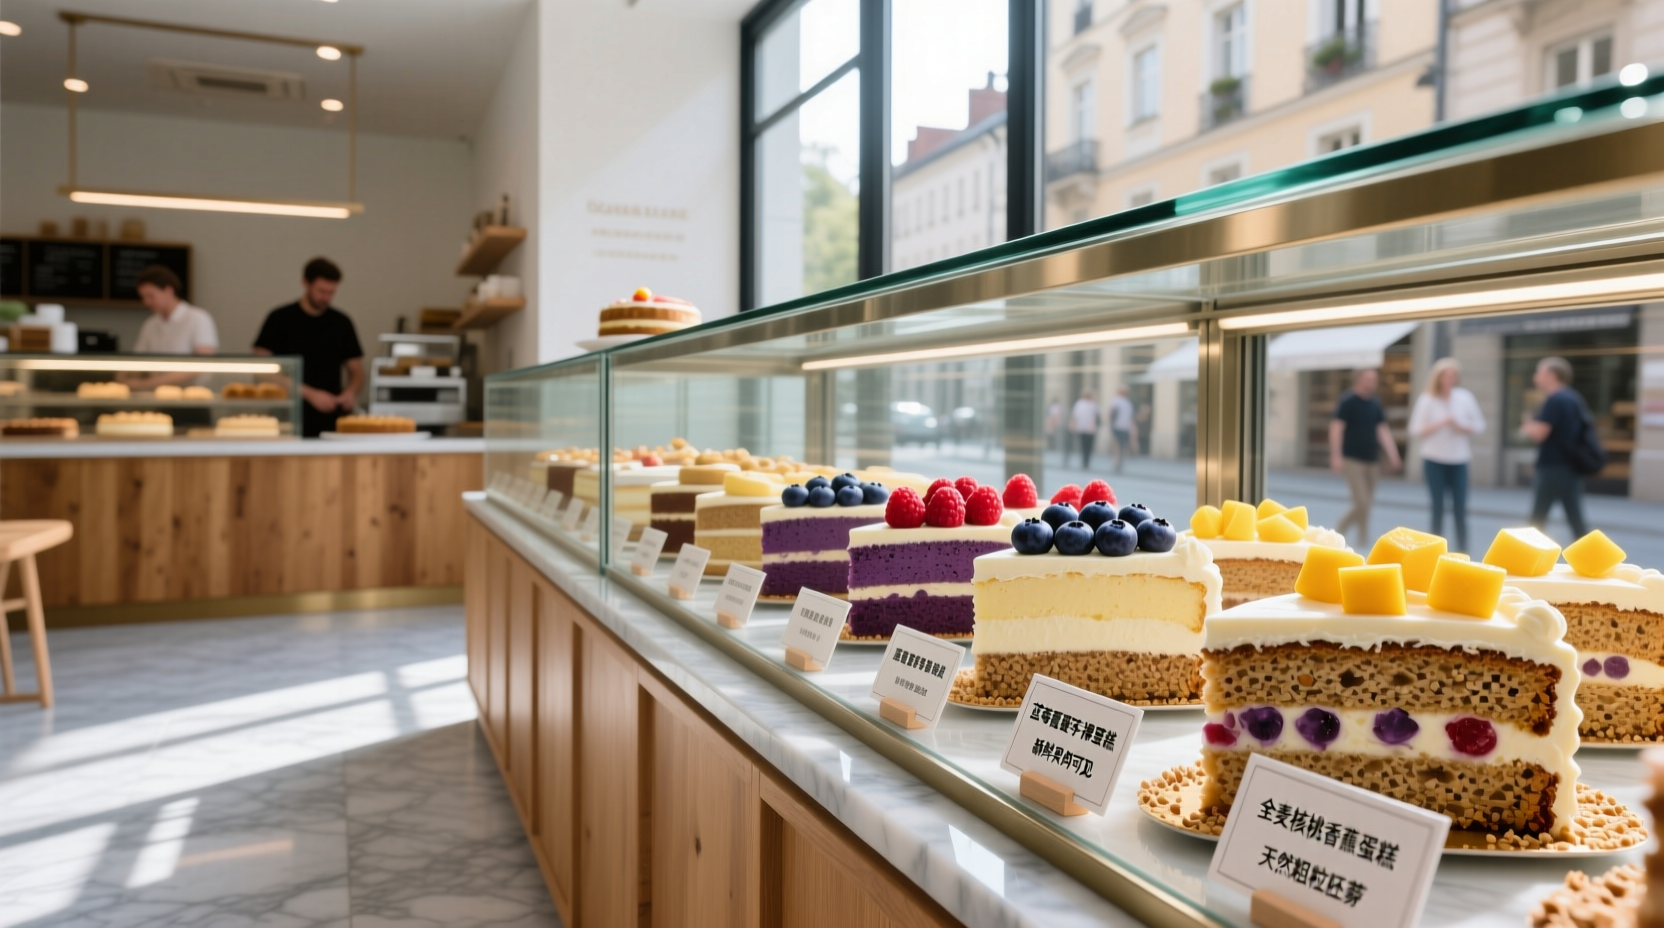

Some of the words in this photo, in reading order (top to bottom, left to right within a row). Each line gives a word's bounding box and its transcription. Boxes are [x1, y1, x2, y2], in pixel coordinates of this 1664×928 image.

[1257, 797, 1400, 871] 全麦核桃香蕉蛋糕
